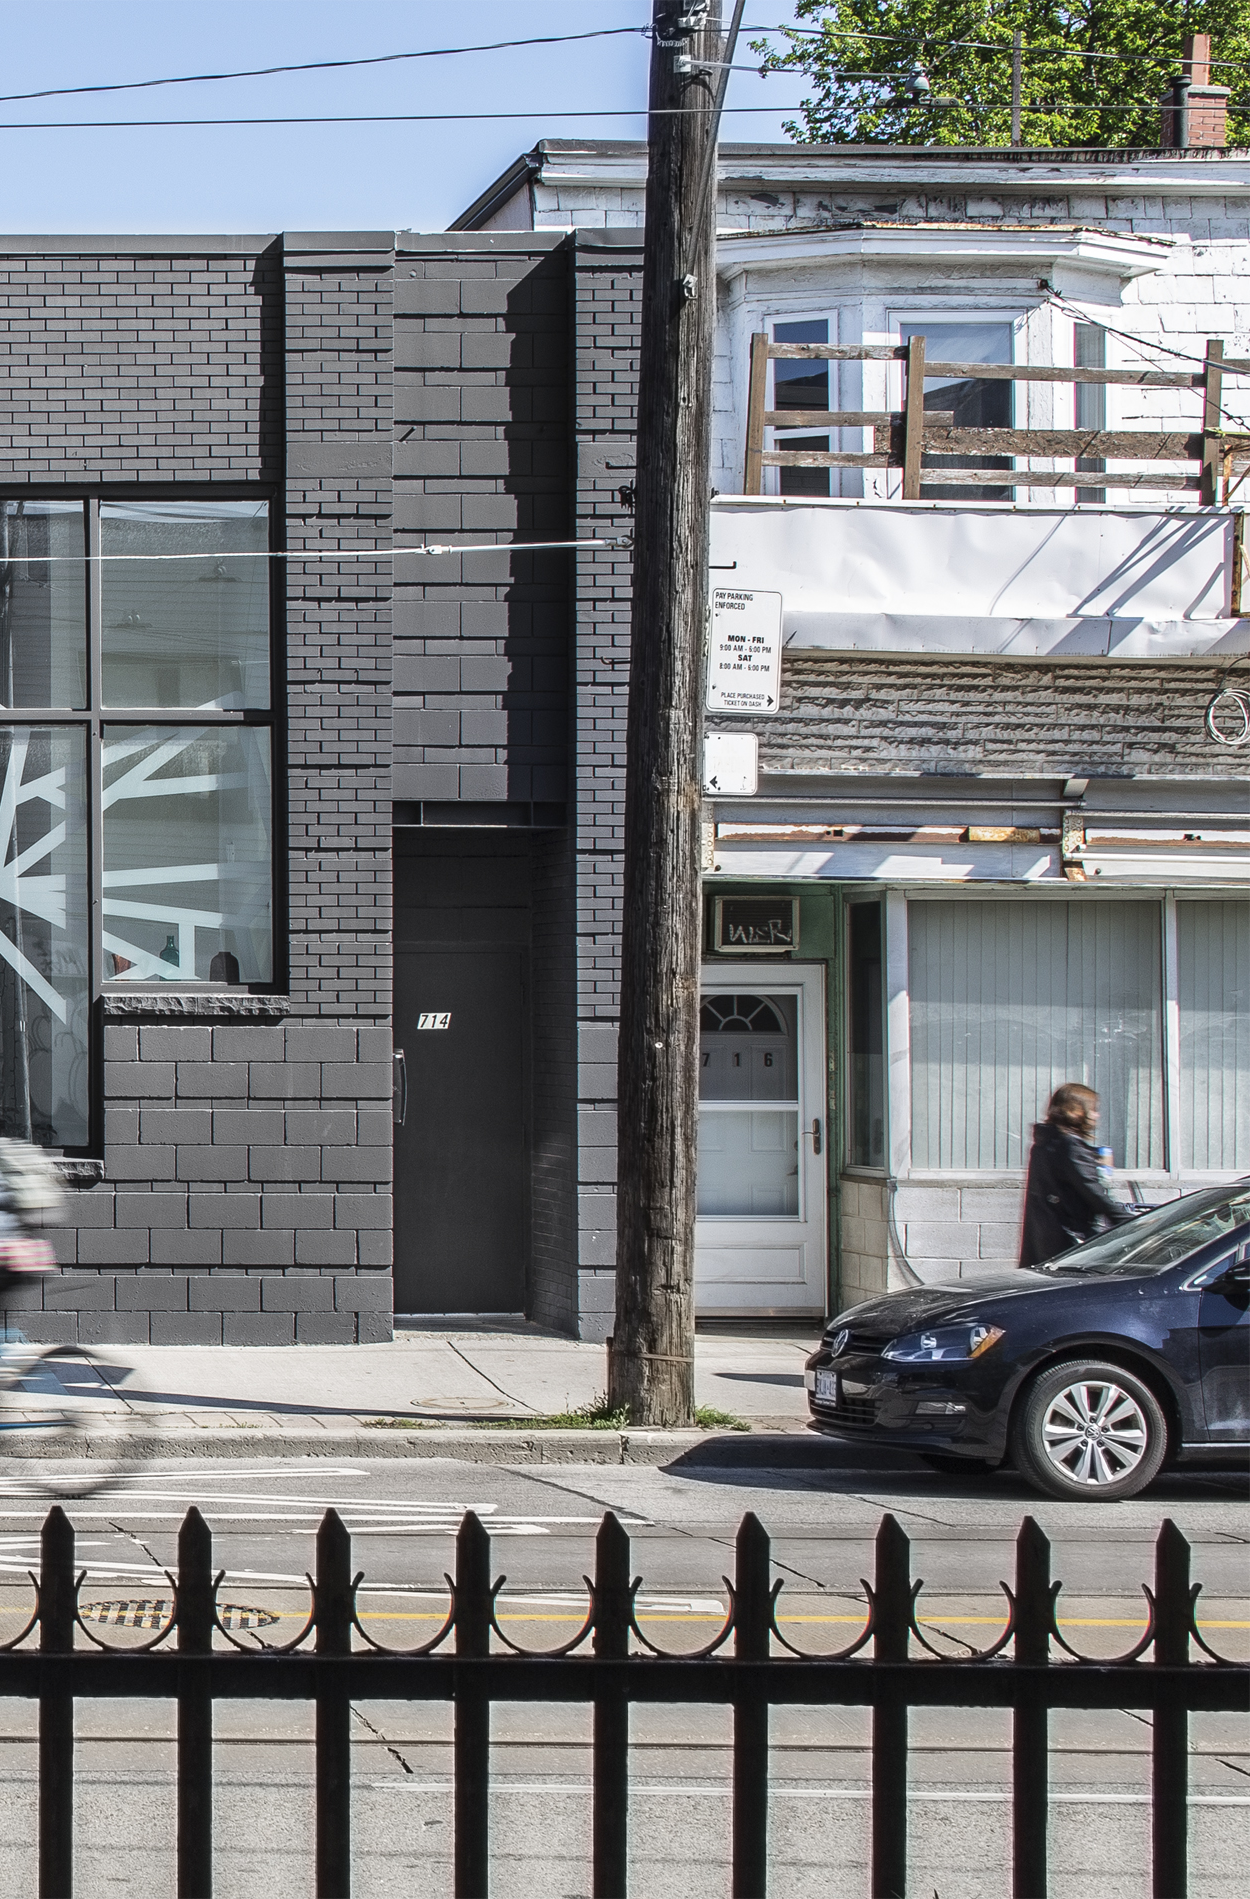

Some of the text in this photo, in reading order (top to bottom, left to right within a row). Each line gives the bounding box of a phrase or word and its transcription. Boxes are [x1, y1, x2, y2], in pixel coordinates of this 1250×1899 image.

[715, 592, 753, 601] PAY PARKING
[715, 601, 746, 610] ENFORCED
[752, 636, 765, 644] FRI
[719, 644, 731, 652] 9:00
[762, 646, 772, 654] PM
[719, 662, 731, 670] 8:00
[420, 1014, 449, 1028] 714
